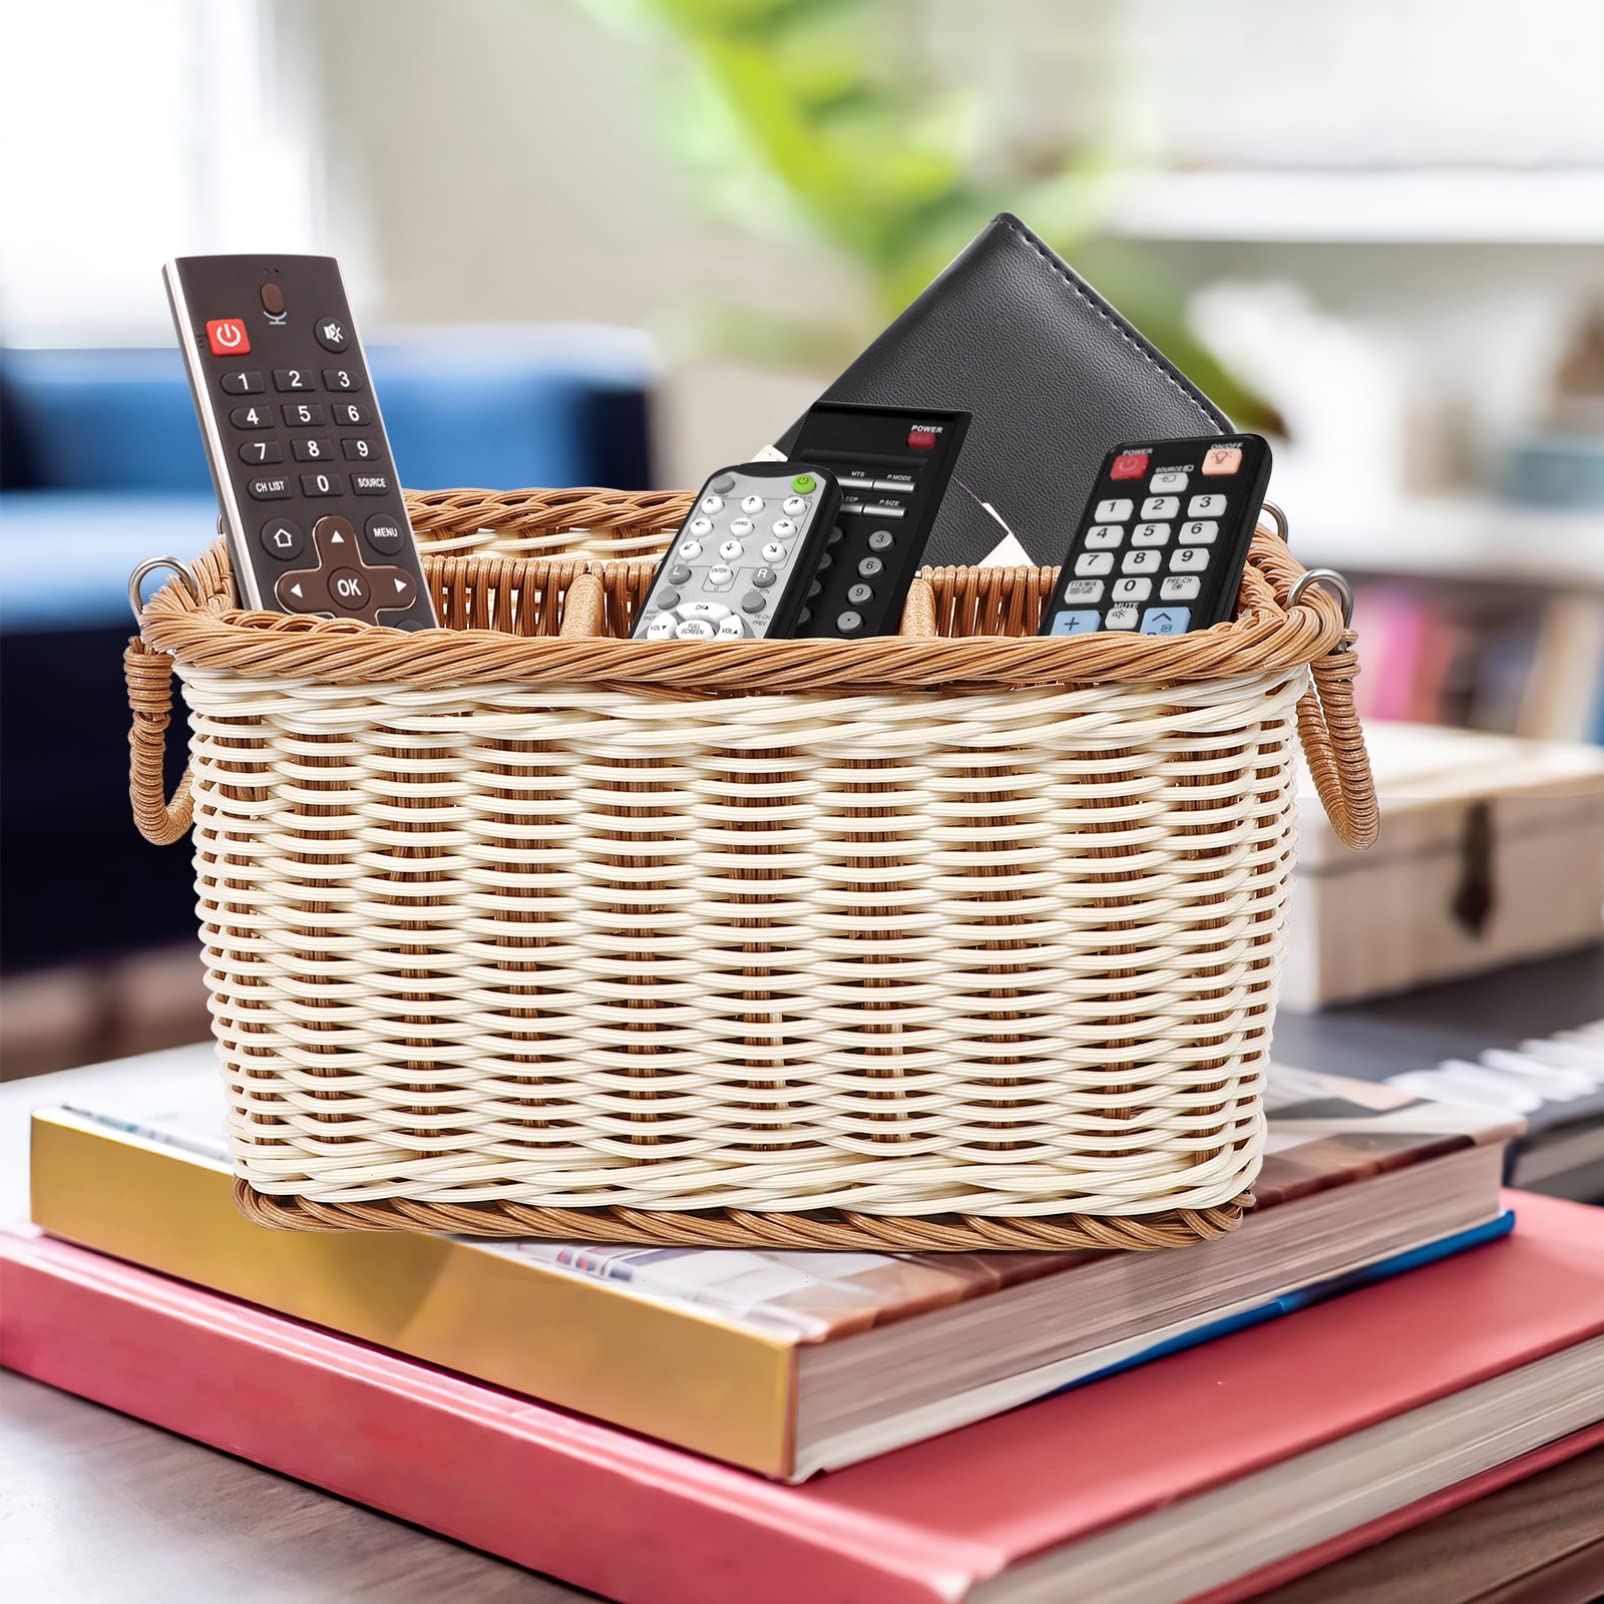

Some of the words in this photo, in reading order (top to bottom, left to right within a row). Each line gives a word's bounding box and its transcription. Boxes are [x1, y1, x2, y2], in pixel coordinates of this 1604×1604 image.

[238, 373, 248, 390] 1
[289, 371, 302, 387] 2
[340, 371, 350, 387] 3
[247, 408, 258, 425] 4
[299, 406, 311, 422] 5
[348, 406, 360, 421] 6
[911, 425, 943, 433] POWER
[254, 443, 266, 459] 7
[307, 440, 319, 456] 8
[357, 441, 369, 456] 9
[1122, 448, 1153, 456] POWER
[256, 483, 268, 492] CH
[270, 481, 284, 491] LIST
[317, 476, 328, 492] 0
[358, 478, 386, 488] SOURCE
[1108, 502, 1116, 512] 1
[1152, 499, 1164, 510] 2
[1200, 497, 1211, 508] 3
[374, 527, 397, 538] MENU
[1097, 528, 1108, 538] 4
[1143, 525, 1155, 536] 5
[1191, 523, 1202, 534] 6
[876, 534, 884, 543] 3
[1087, 555, 1098, 566] 7
[1134, 552, 1146, 563] 8
[1182, 551, 1194, 562] 9
[866, 561, 874, 569] 6
[757, 569, 767, 577] R
[337, 579, 360, 596] OK
[1124, 580, 1136, 591] 0
[855, 588, 864, 596] 9
